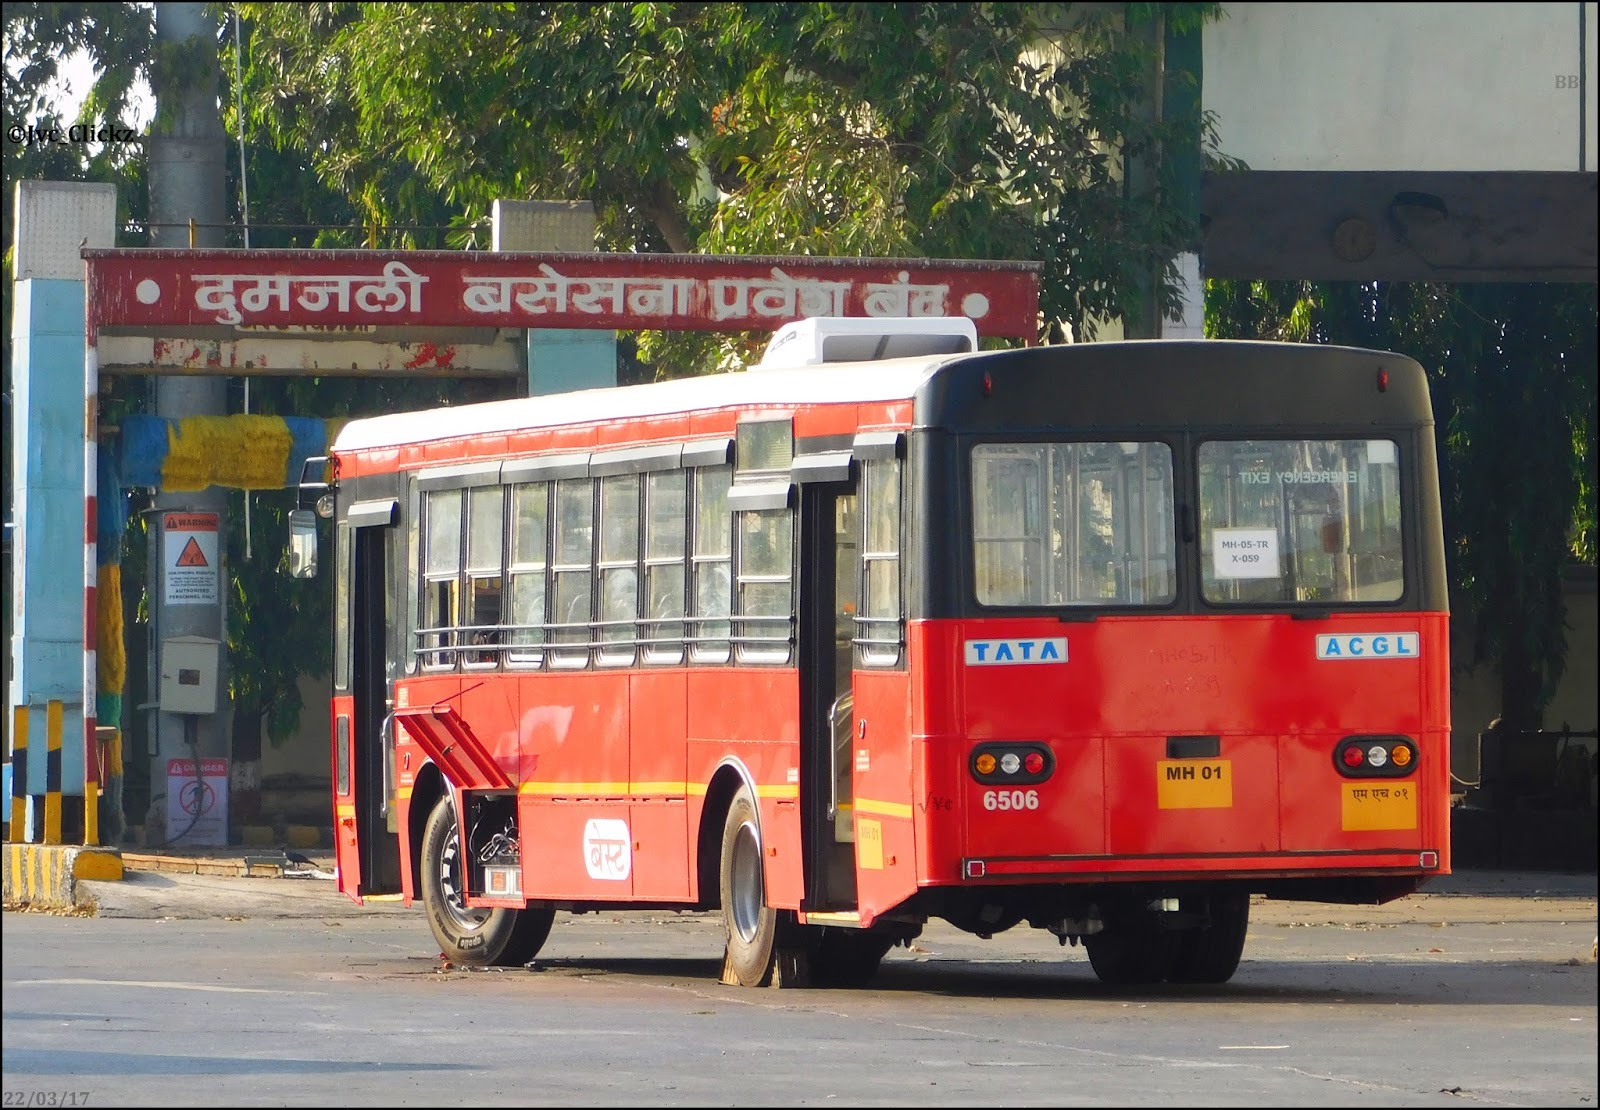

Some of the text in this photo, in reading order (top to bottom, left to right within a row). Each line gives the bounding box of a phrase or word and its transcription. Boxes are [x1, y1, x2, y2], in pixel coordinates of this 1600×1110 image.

[191, 261, 429, 324] दुमजली
[463, 263, 697, 315] बसेसना
[178, 518, 217, 527] WARNING
[1222, 540, 1269, 550] MH-05-TR
[1232, 554, 1260, 563] X-059
[973, 641, 1059, 661] TATA
[1325, 636, 1411, 656] ACGL
[1166, 766, 1222, 780] MH 01
[983, 790, 1039, 811] 6506
[1352, 789, 1368, 802] एम
[1371, 788, 1389, 802] एच
[861, 825, 879, 841] MH 01
[460, 936, 482, 950] apollo
